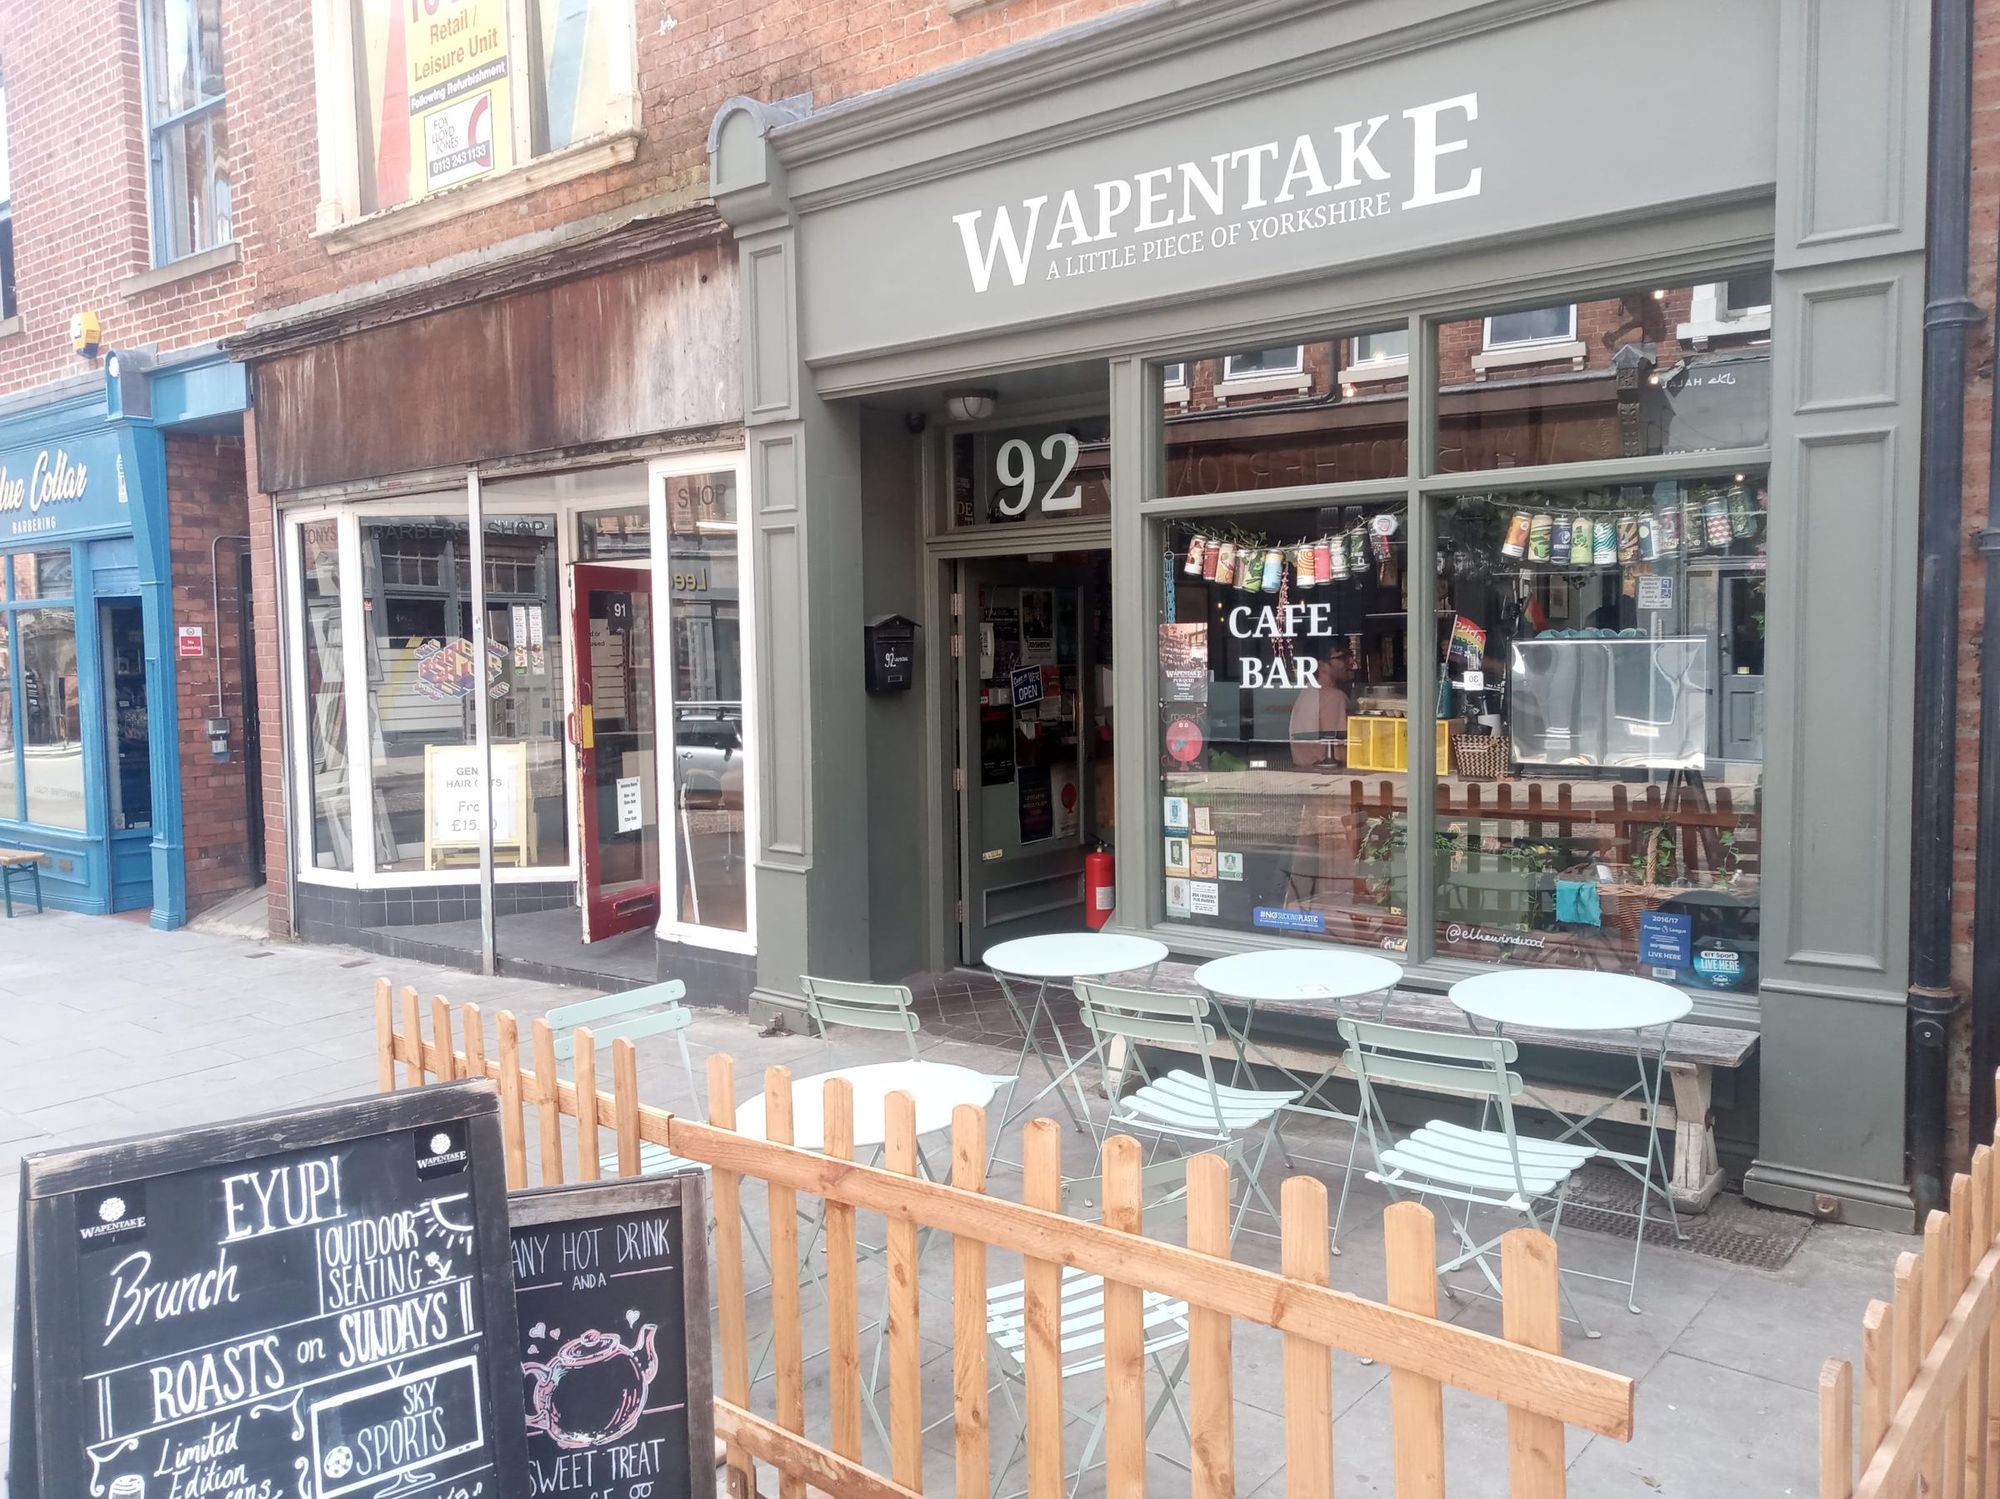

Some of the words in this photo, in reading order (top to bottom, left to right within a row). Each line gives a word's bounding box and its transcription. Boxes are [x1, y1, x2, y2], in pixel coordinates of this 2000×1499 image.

[430, 8, 468, 44] Retail
[414, 47, 464, 81] Leisure
[469, 28, 498, 57] Unit
[411, 87, 446, 111] Following
[447, 61, 505, 95] Refurbishment
[432, 126, 455, 144] LLOYD
[436, 136, 459, 154] JONES
[433, 160, 451, 173] 0113
[452, 153, 467, 167] 243
[467, 144, 486, 160] 1133
[953, 92, 1482, 292] WAPENTAKE
[1046, 260, 1061, 281] A
[1066, 248, 1136, 277] LITTLE
[1143, 232, 1205, 263] PIECE
[1211, 223, 1242, 248] OF
[1248, 192, 1392, 241] YORKSHIRE
[30, 449, 87, 512] Collar
[996, 433, 1082, 516] 92
[13, 516, 56, 535] BARBERING
[614, 603, 626, 617] 91
[1228, 603, 1332, 639] CAFE
[884, 652, 897, 668] 92
[1239, 656, 1322, 689] BAR
[1018, 685, 1038, 701] OPEN
[446, 779, 472, 788] HAIR
[456, 767, 479, 776] GEN
[458, 800, 480, 813] Fro
[1701, 958, 1718, 970] LIVE
[1719, 960, 1740, 971] HERE
[417, 1150, 467, 1169] WAPENTAKE
[222, 1156, 342, 1242] EYUP!
[80, 1216, 147, 1239] WAPENTAKE
[326, 1211, 418, 1267] OUTDOOR
[562, 1228, 603, 1271] HOT
[617, 1219, 670, 1263] DRINK
[103, 1248, 240, 1347] Brunch
[329, 1250, 421, 1311] SEATING
[572, 1273, 597, 1291] AND
[598, 1272, 607, 1288] A
[150, 1336, 285, 1424] ROASTS
[297, 1340, 326, 1365] on
[339, 1292, 448, 1368] SUNDAYS
[403, 1378, 438, 1416] SKY
[153, 1415, 242, 1477] Limited
[356, 1406, 446, 1475] SPORTS
[606, 1438, 666, 1481] TREAT
[168, 1460, 249, 1499] Edition
